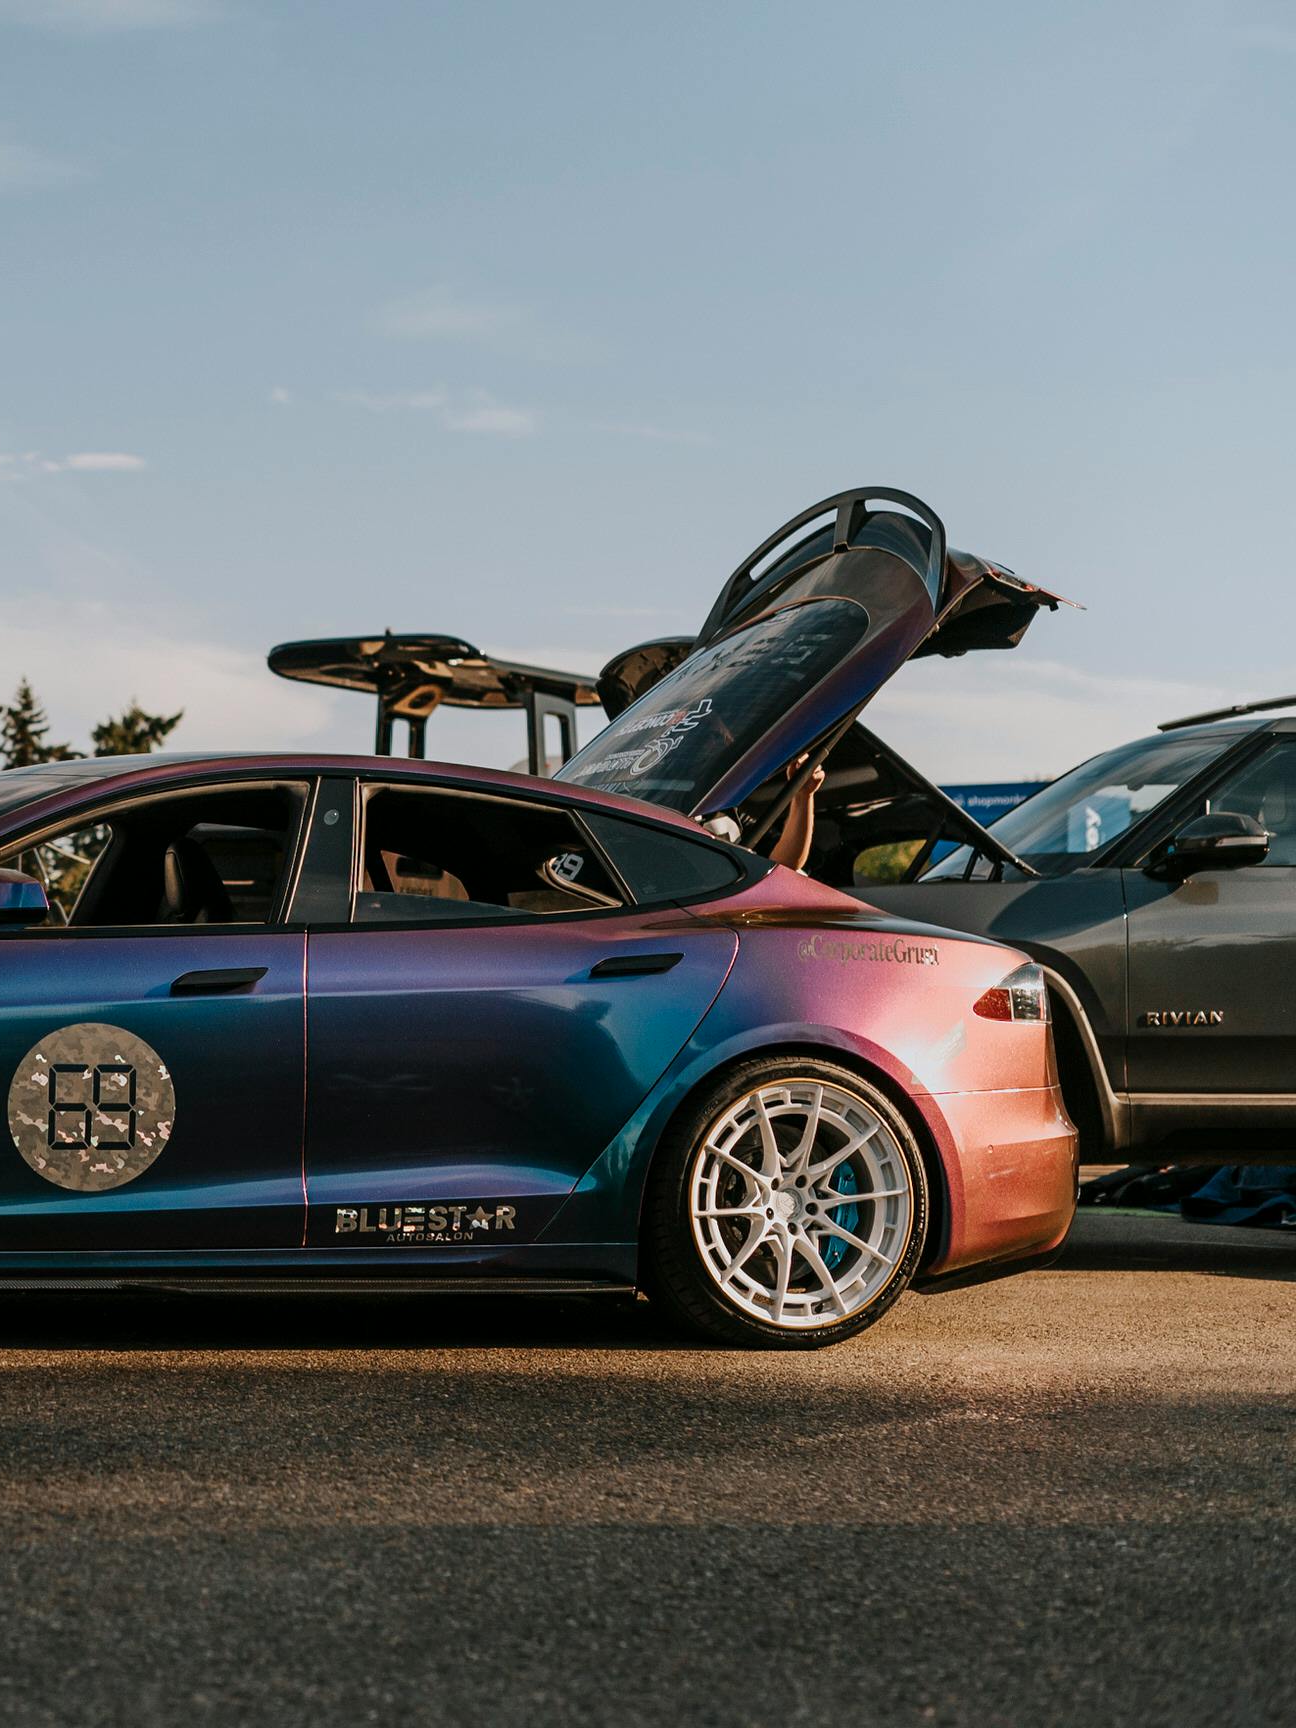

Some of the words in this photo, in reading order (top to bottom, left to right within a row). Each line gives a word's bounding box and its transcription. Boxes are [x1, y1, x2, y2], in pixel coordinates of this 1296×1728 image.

[1147, 1011, 1224, 1026] RIVIAN
[48, 1064, 137, 1150] 69
[386, 1231, 474, 1243] AUTOSALON
